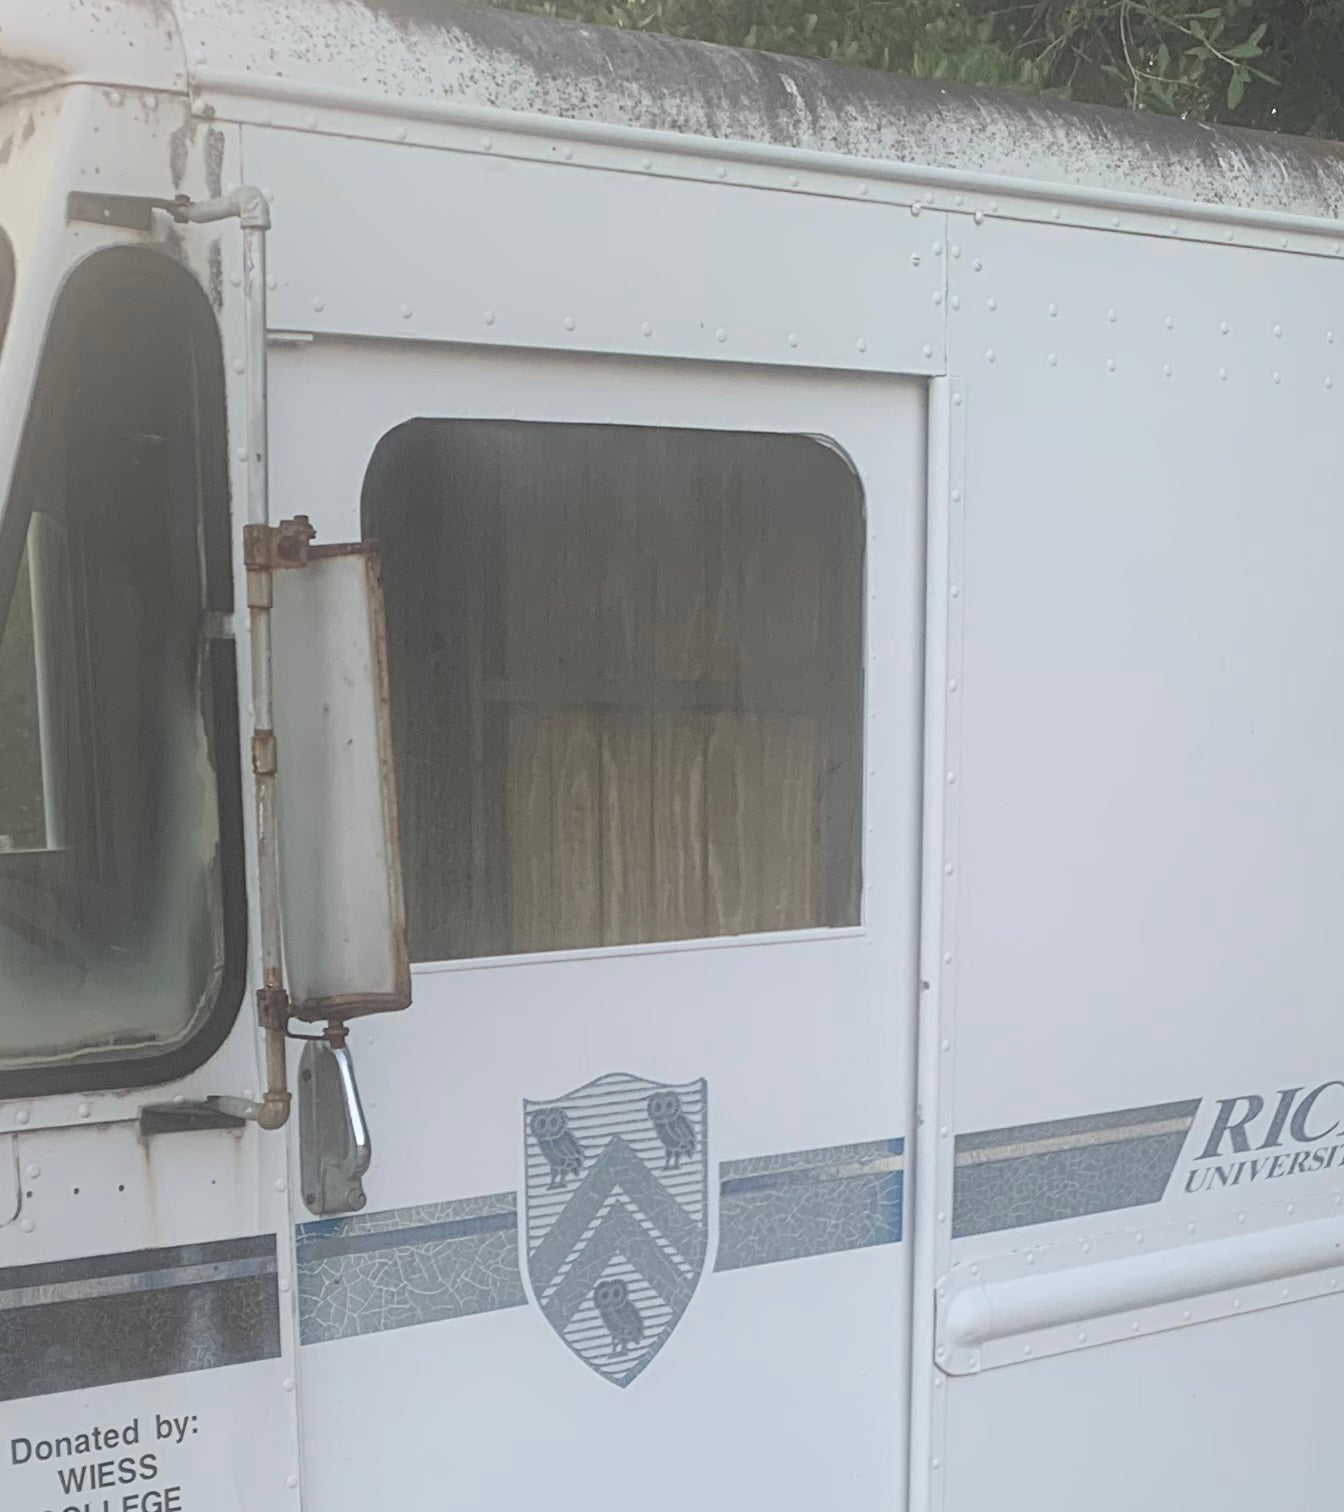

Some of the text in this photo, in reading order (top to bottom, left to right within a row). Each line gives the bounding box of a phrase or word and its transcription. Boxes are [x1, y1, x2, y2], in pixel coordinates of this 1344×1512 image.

[10, 1414, 199, 1465] Donated by:
[57, 1453, 158, 1495] WIESS
